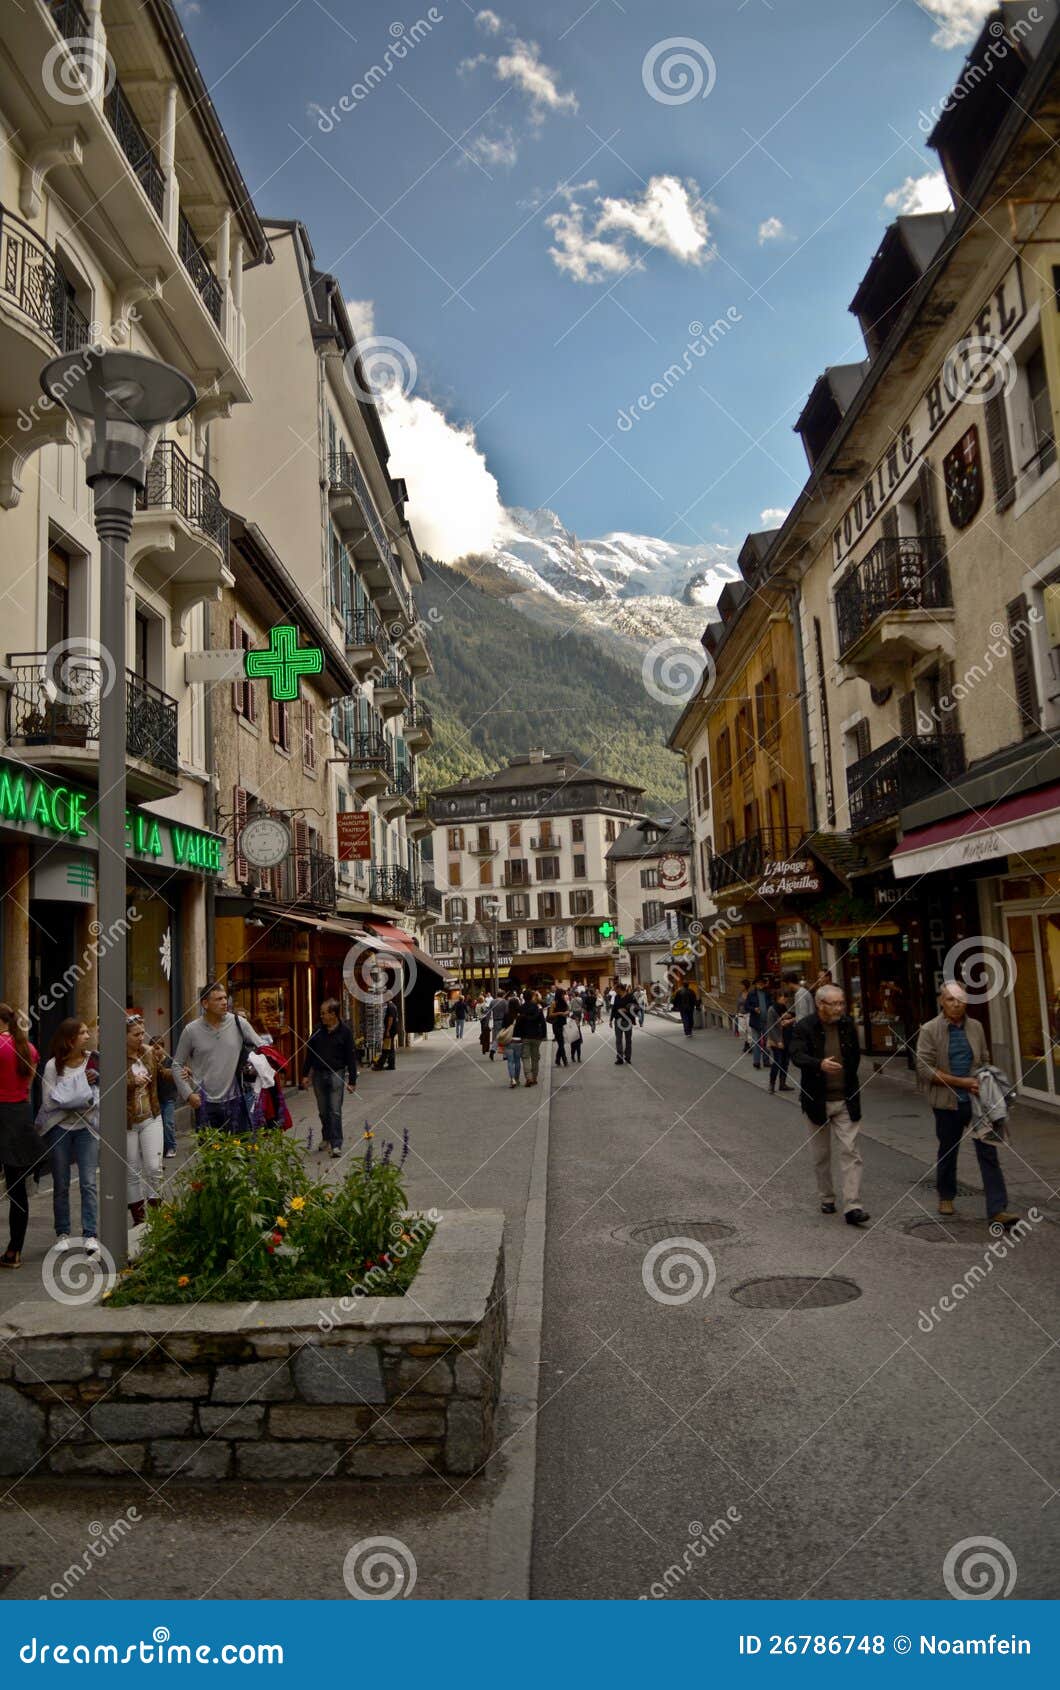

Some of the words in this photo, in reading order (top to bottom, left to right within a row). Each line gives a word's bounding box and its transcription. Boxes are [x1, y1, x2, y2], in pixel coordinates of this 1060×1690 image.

[832, 423, 914, 561] TOURING
[926, 283, 1016, 432] HOTEL
[134, 814, 163, 858] LA
[763, 861, 806, 876] L'Alpage
[758, 881, 775, 895] des
[775, 875, 819, 894] Aiguilles
